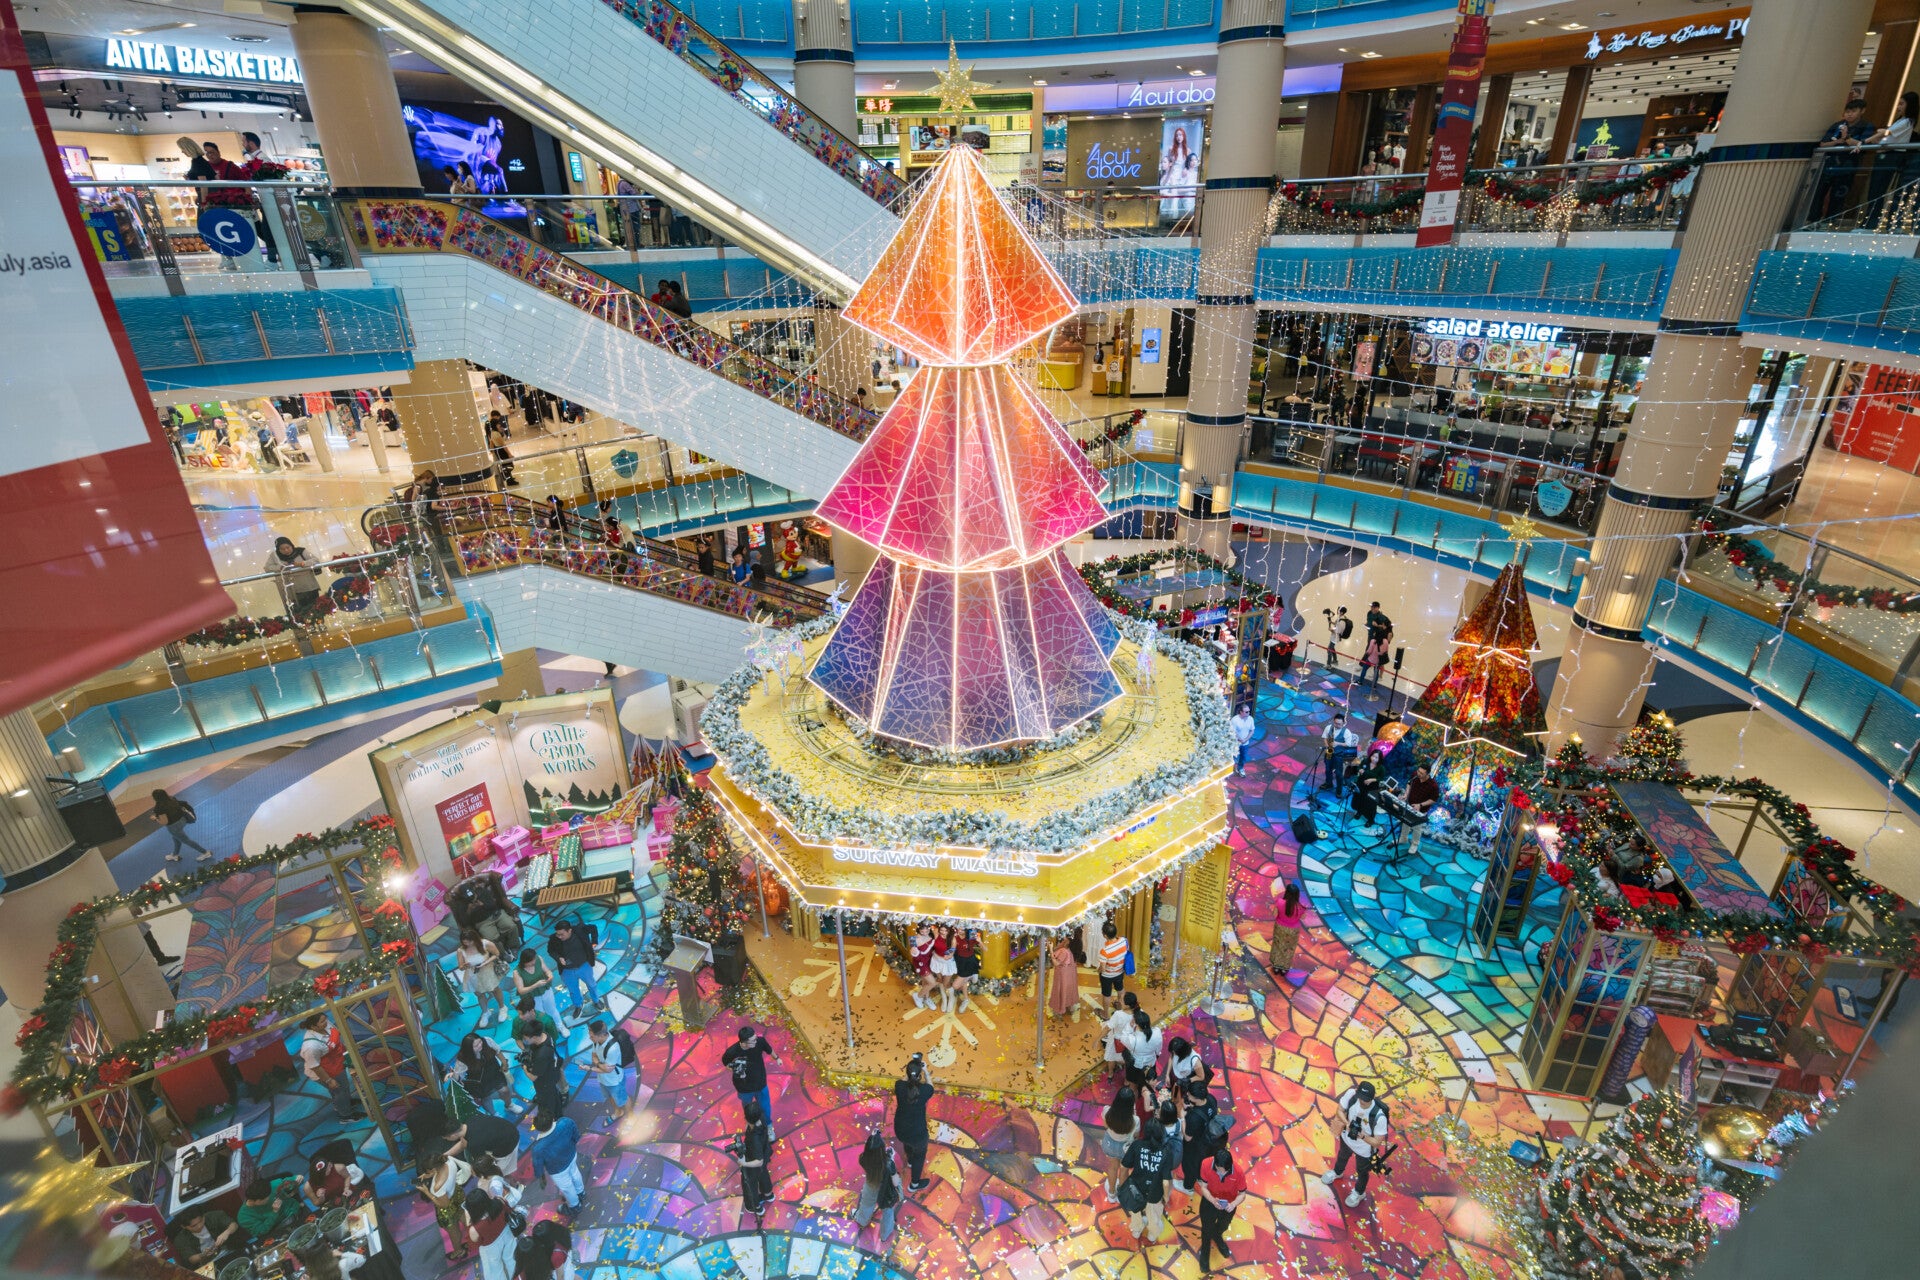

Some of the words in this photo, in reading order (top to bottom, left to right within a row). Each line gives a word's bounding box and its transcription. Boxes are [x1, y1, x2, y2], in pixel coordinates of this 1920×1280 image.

[106, 38, 172, 71] ANTA
[175, 46, 303, 83] BASKETBA
[200, 91, 232, 100] BASKETBALL
[1145, 87, 1174, 106] cut
[1103, 147, 1132, 166] cut
[1087, 158, 1142, 179] above
[214, 221, 241, 244] G
[1426, 318, 1482, 337] salad
[1486, 321, 1563, 342] atelier
[187, 454, 229, 470] SALE
[1445, 470, 1474, 490] YES
[537, 723, 578, 745] BATH
[436, 742, 459, 758] YOUR
[464, 739, 490, 756] BEGINS
[542, 743, 585, 760] BODY
[441, 761, 464, 778] NOW
[543, 755, 597, 775] WORKS
[443, 799, 470, 816] PERFECT
[470, 792, 484, 803] GIFT
[447, 809, 469, 822] STARTS
[469, 800, 483, 813] HERE
[833, 846, 941, 869] SUNWAY
[950, 856, 1039, 877] MALLS
